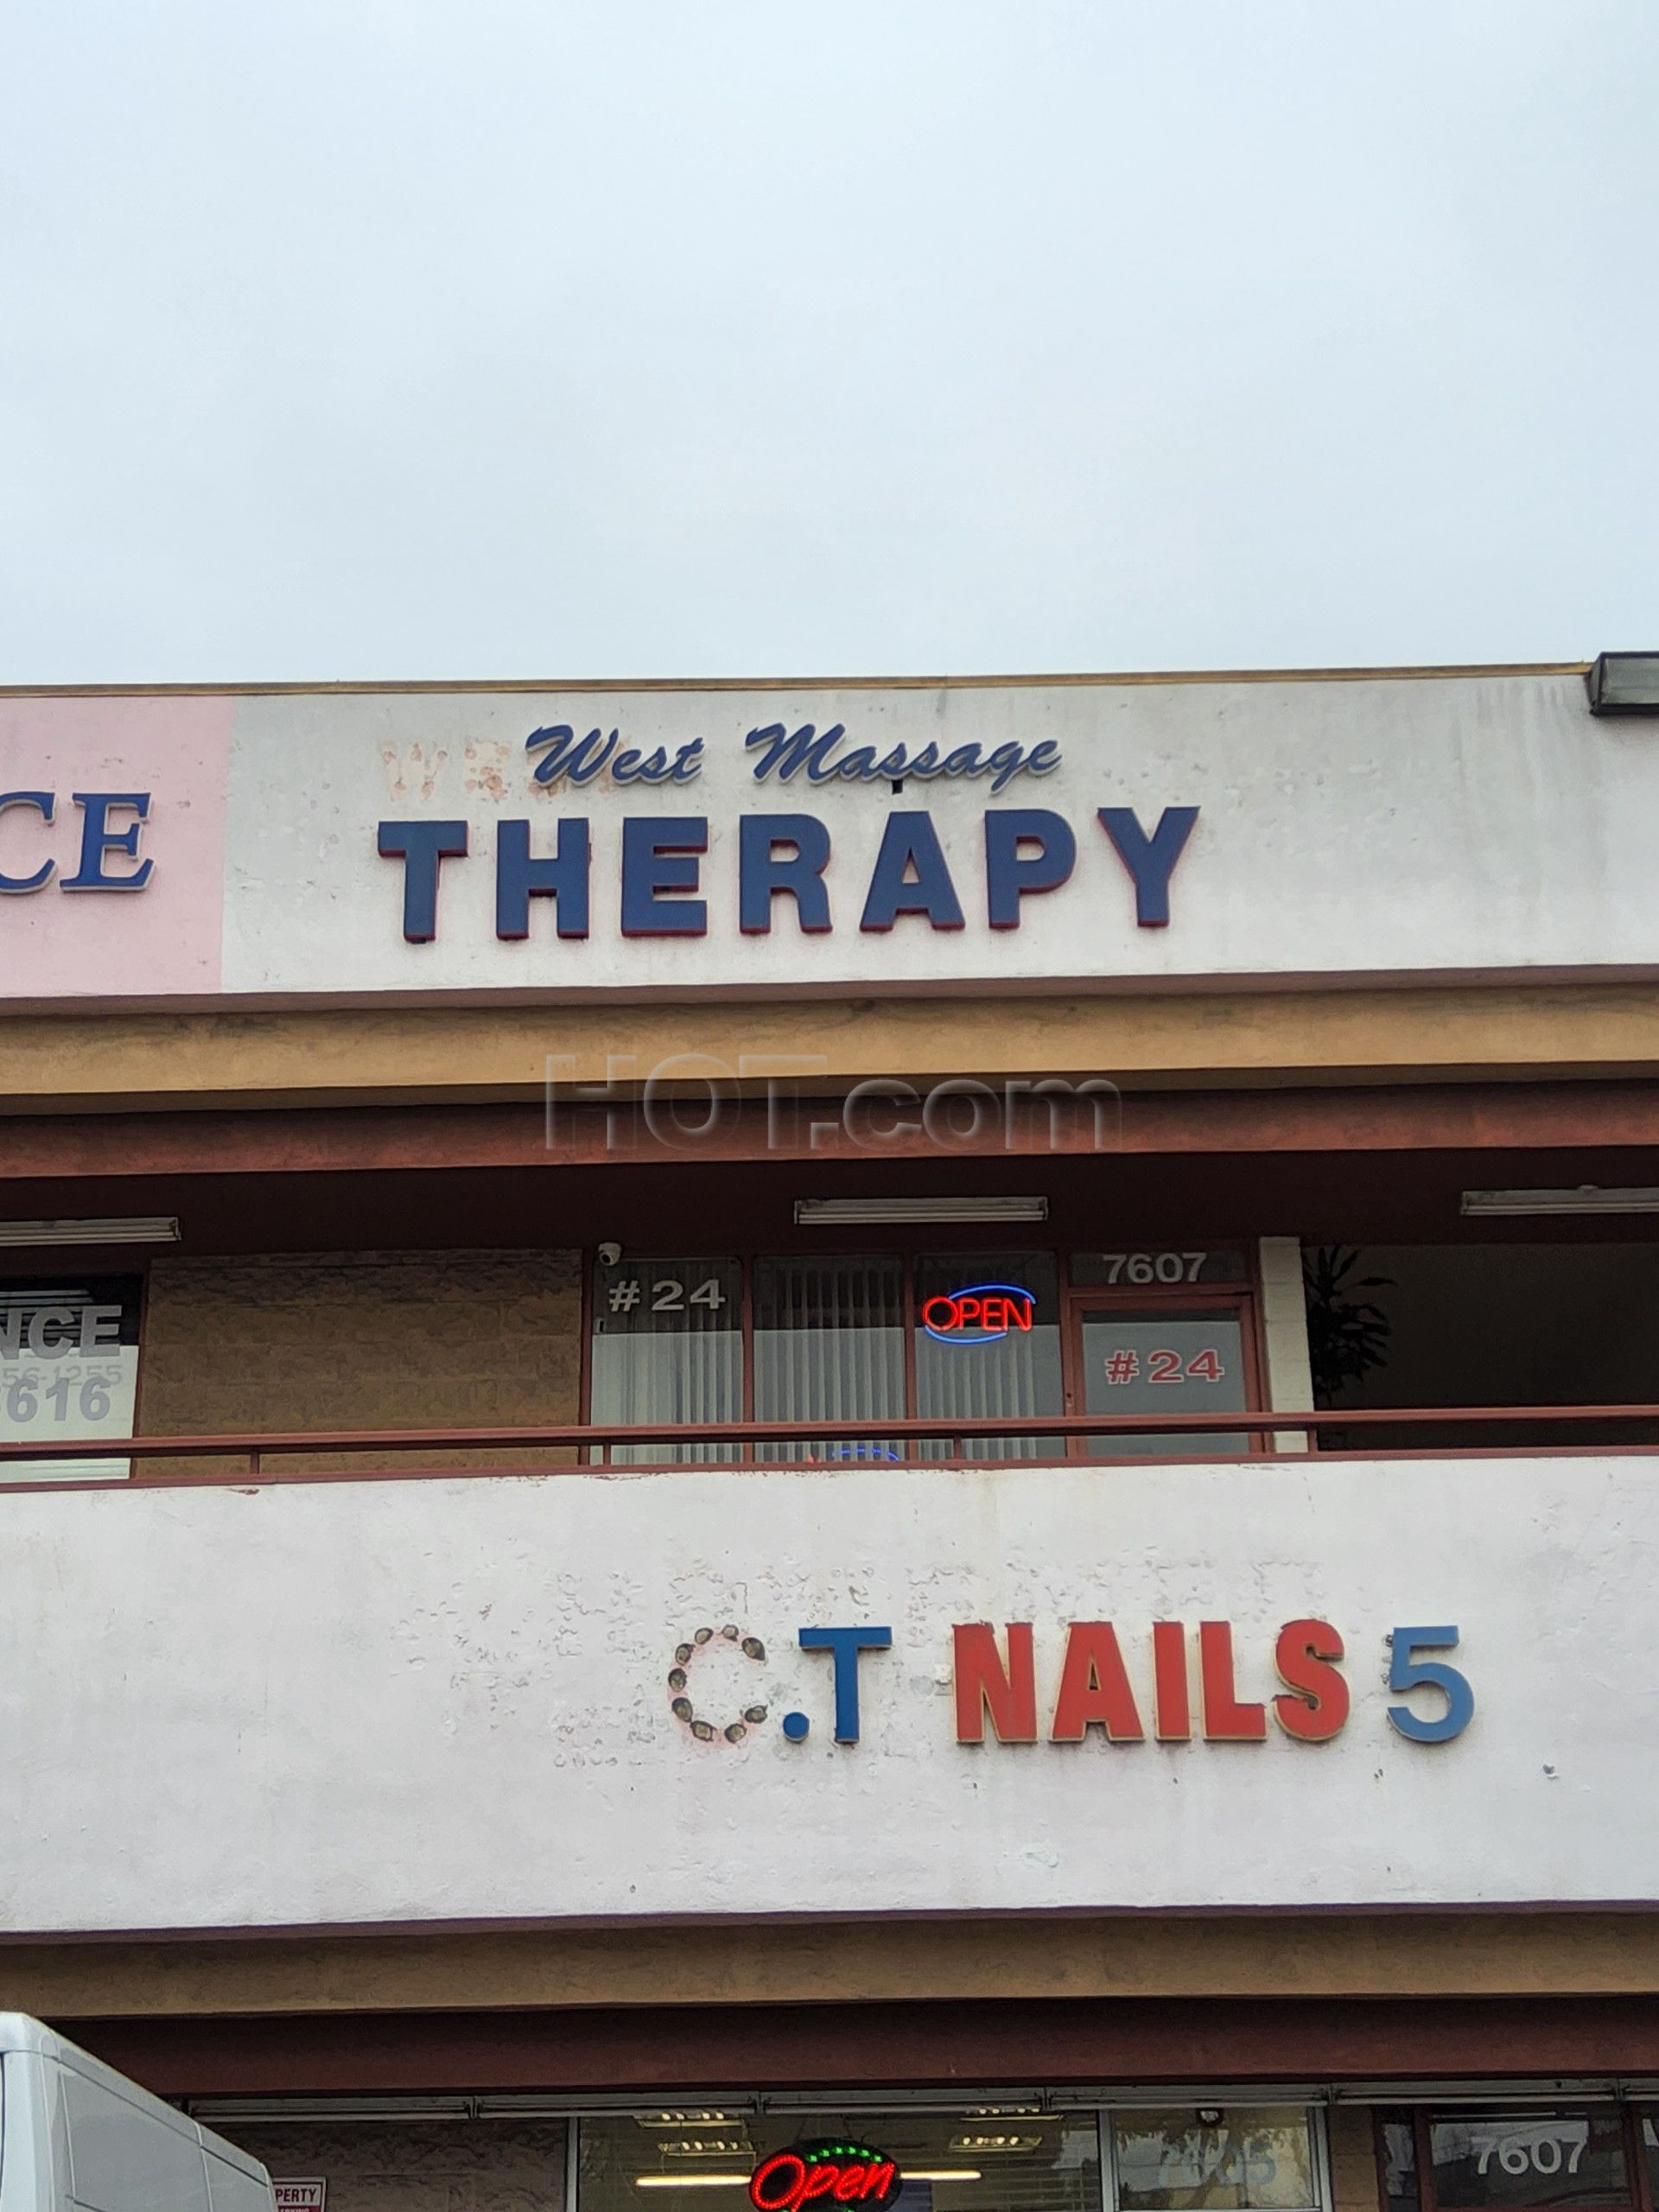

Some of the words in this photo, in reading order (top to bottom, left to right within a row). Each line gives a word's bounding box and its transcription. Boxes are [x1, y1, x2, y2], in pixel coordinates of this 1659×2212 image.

[526, 723, 703, 787] West
[746, 722, 1061, 795] Massage
[378, 805, 1199, 944] THERAPY
[1103, 1251, 1207, 1285] 7607
[922, 1296, 1033, 1333] OPEN
[951, 1618, 1351, 1746] NAILS
[1386, 1624, 1476, 1745] 5
[751, 2153, 896, 2212] Open
[1469, 2136, 1588, 2176] 7607
